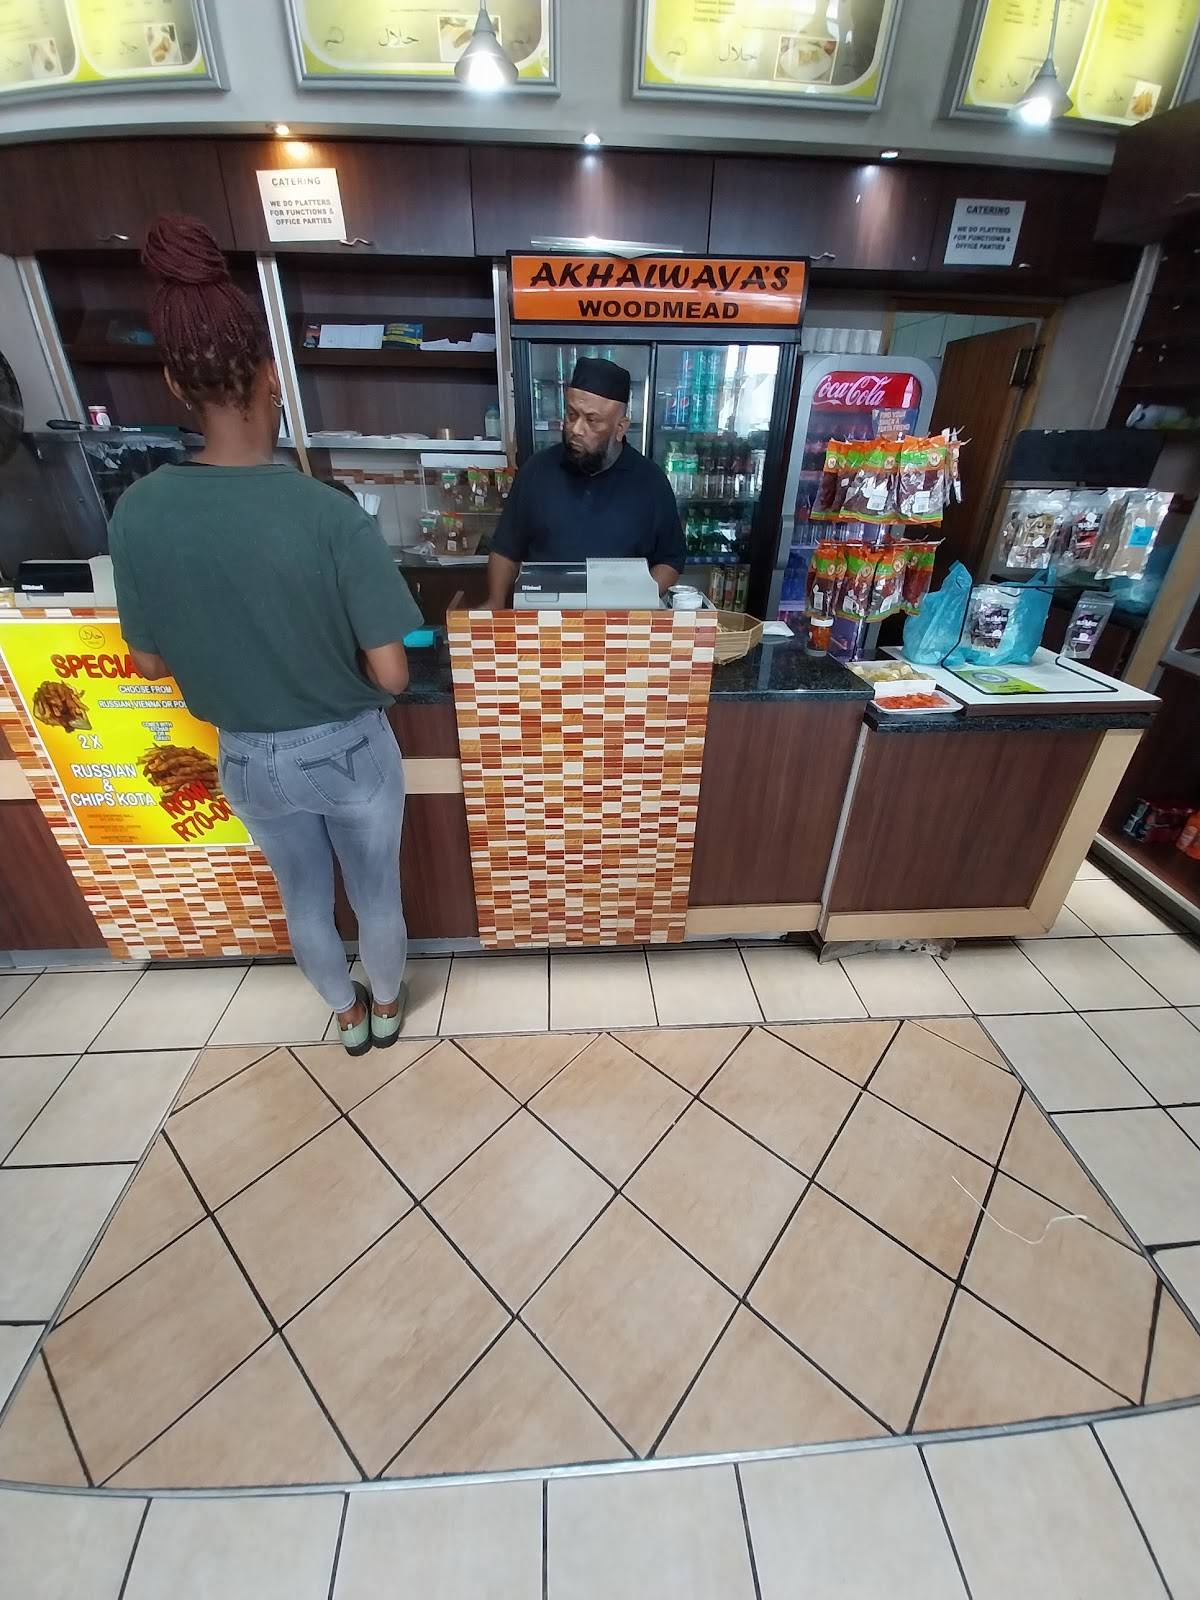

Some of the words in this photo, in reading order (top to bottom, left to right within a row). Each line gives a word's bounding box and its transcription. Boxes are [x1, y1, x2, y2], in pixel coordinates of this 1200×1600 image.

[271, 177, 321, 187] CATERING
[269, 200, 281, 208] WE
[295, 199, 331, 207] PLATTERS
[270, 209, 284, 217] FOR
[286, 208, 327, 216] FUNCTIONS
[966, 205, 1011, 216] CATERING
[275, 218, 301, 226] OFFICE
[303, 217, 332, 225] PARTIES
[980, 226, 1012, 234] PLATTERS
[953, 234, 966, 242] FOR
[968, 235, 1005, 243] FUNCTIONS
[980, 243, 1006, 251] PARTIES
[529, 262, 790, 292] AKHALWAYA'S
[578, 299, 740, 320] WOODMEAD
[51, 654, 144, 679] SPECIA
[119, 685, 150, 694] CHOOSE
[150, 685, 173, 694] FROM
[161, 701, 173, 709] OR
[78, 735, 90, 749] 2
[90, 735, 103, 749] X
[70, 764, 137, 779] RUSSIAN
[102, 778, 114, 792] &
[70, 793, 115, 807] CHIPS
[116, 793, 157, 807] KOTA
[160, 782, 213, 820] NOW
